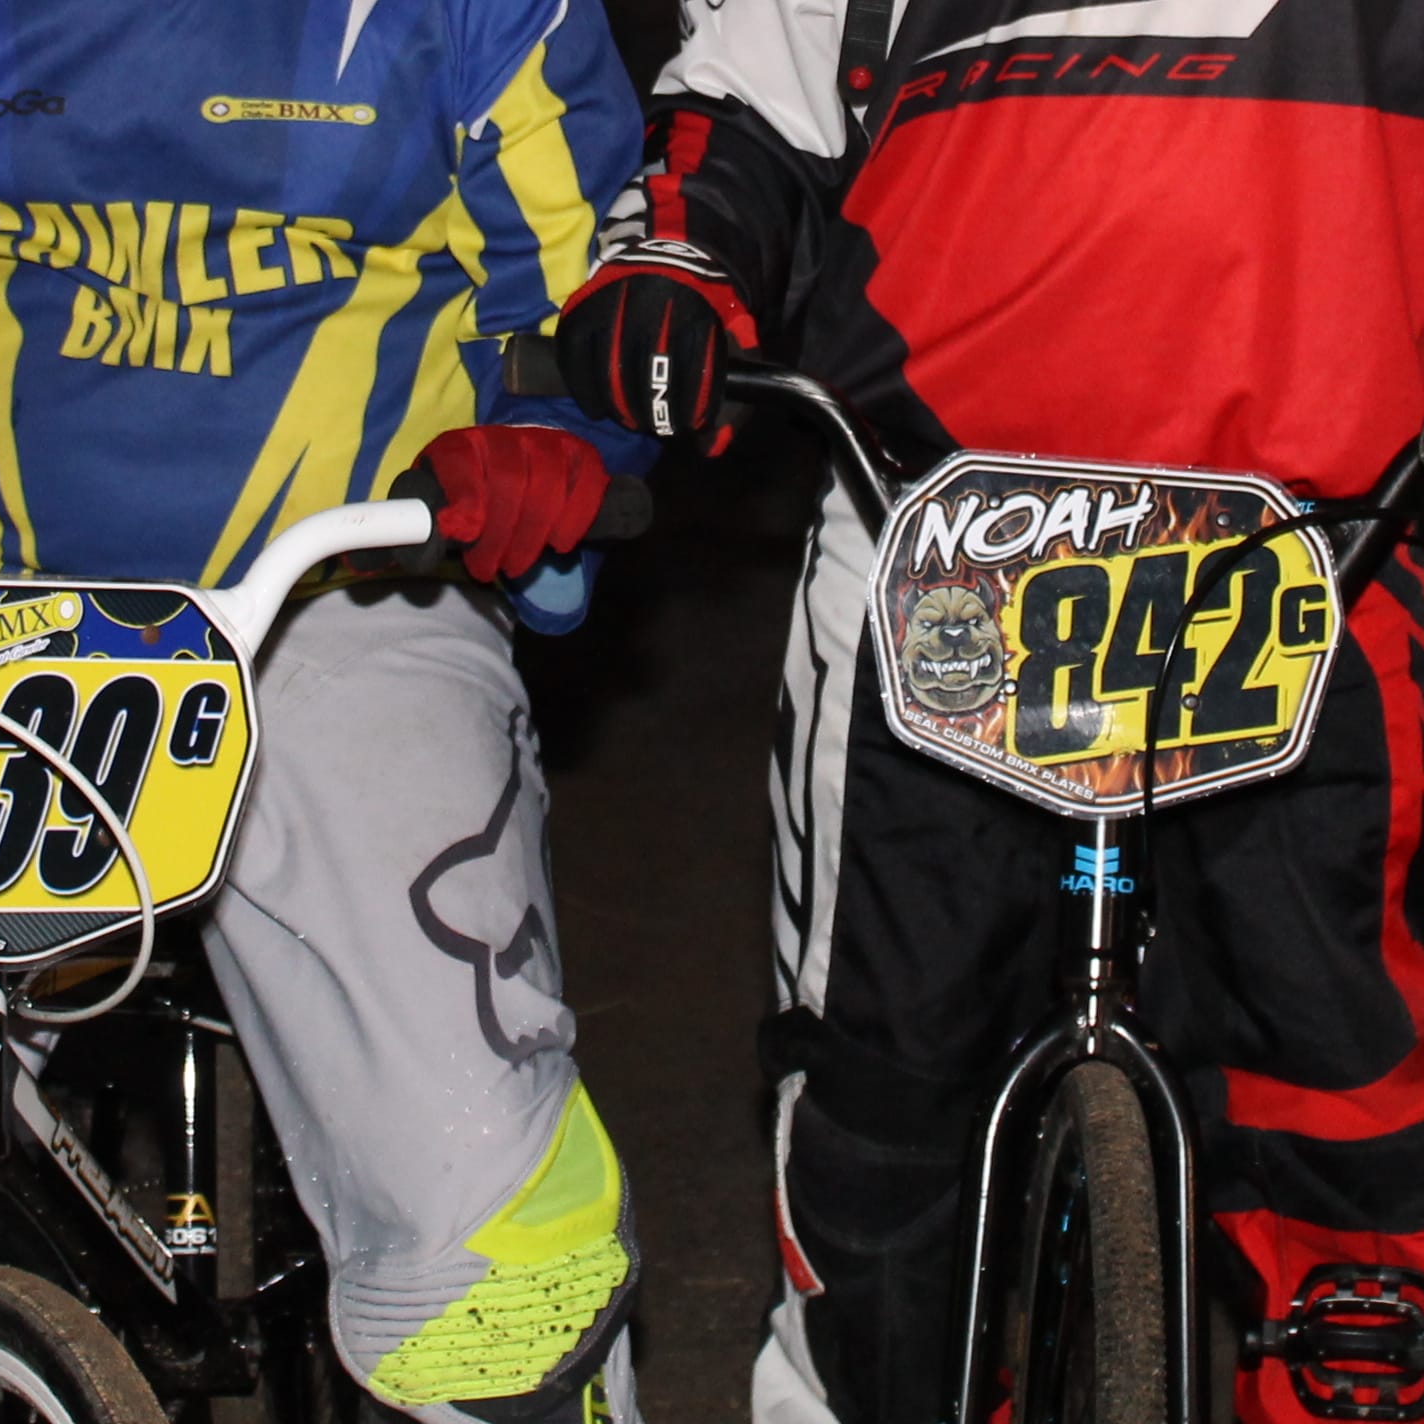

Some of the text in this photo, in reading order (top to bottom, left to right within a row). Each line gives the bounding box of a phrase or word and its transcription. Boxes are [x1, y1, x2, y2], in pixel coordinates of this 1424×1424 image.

[279, 103, 345, 121] BMX
[61, 285, 234, 378] BMX
[914, 482, 1154, 572] NOAH
[1014, 541, 1328, 756] 842 G
[168, 680, 230, 766] G
[903, 709, 1096, 801] SEAL CUSTOM BMX PLATES
[1060, 874, 1135, 894] HARO
